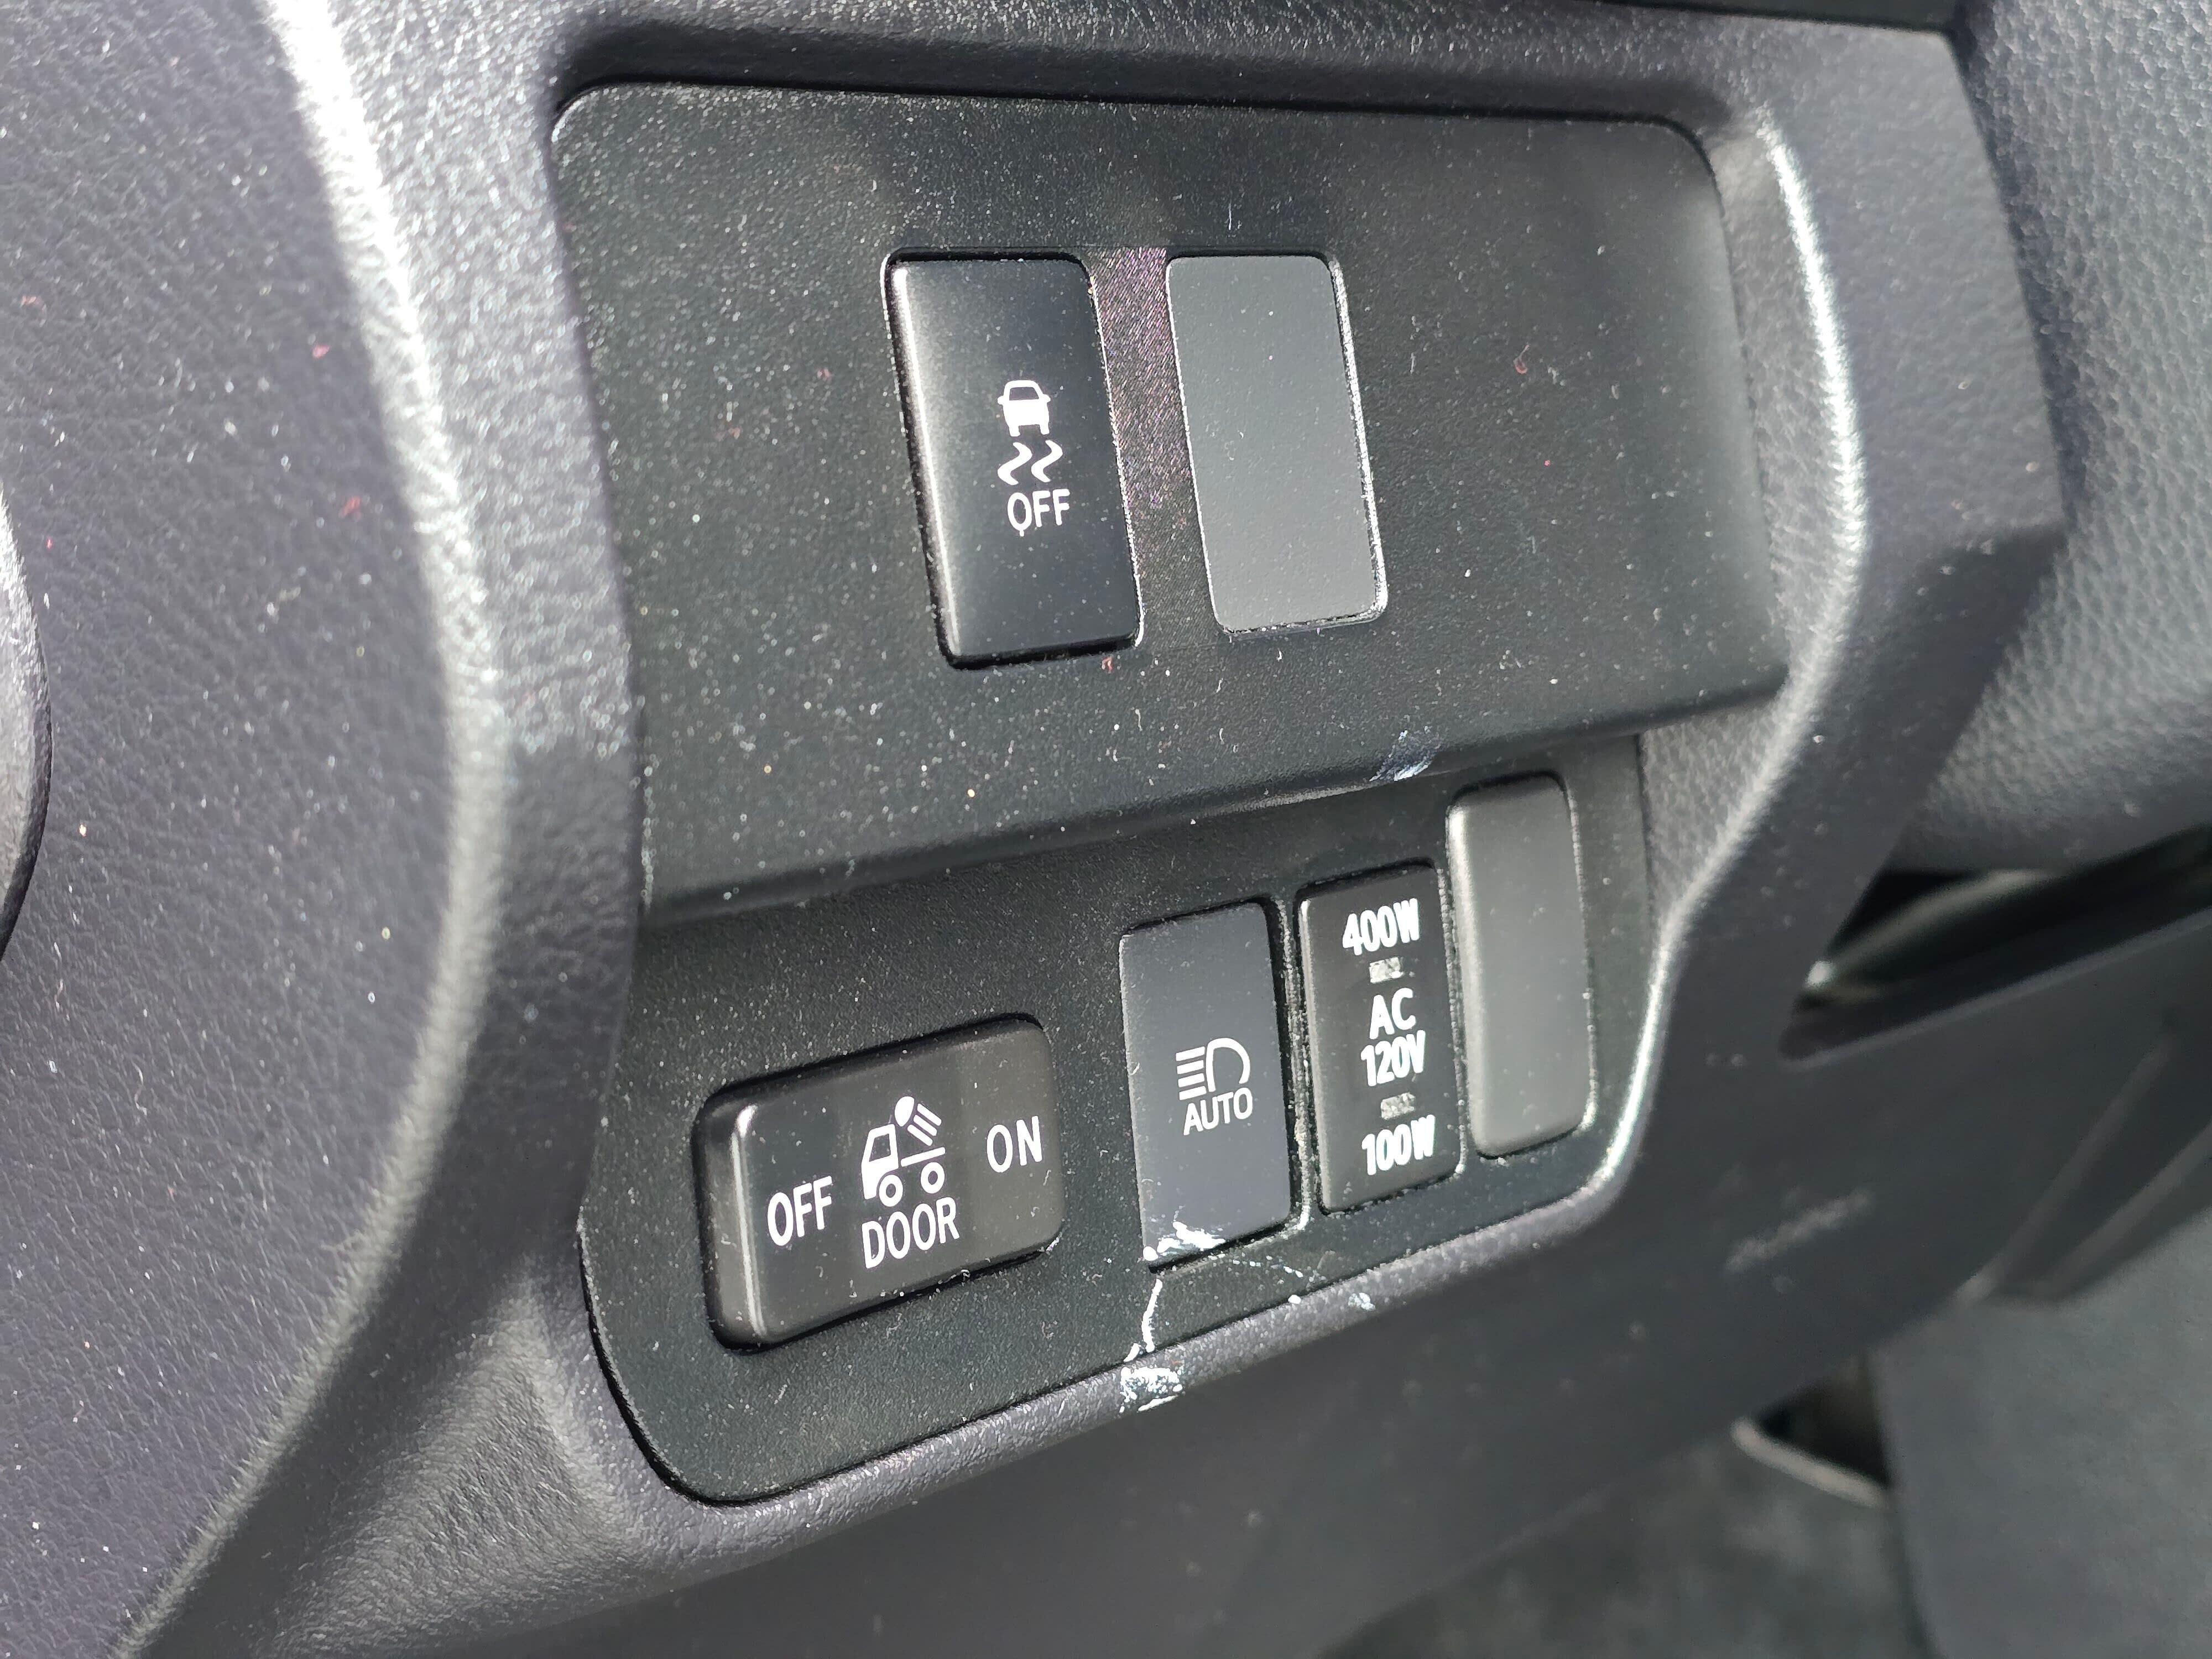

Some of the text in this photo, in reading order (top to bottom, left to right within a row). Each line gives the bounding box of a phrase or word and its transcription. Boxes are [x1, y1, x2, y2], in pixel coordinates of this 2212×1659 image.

[1007, 488, 1071, 531] OFF
[1342, 898, 1420, 956] 400W
[1369, 987, 1417, 1040] AC
[1360, 1030, 1426, 1087] 120V
[1183, 1087, 1254, 1136] AUTO
[987, 1115, 1042, 1173] ON
[1361, 1114, 1436, 1176] 100W
[767, 1175, 833, 1246] OFF
[862, 1197, 960, 1269] DOOR
